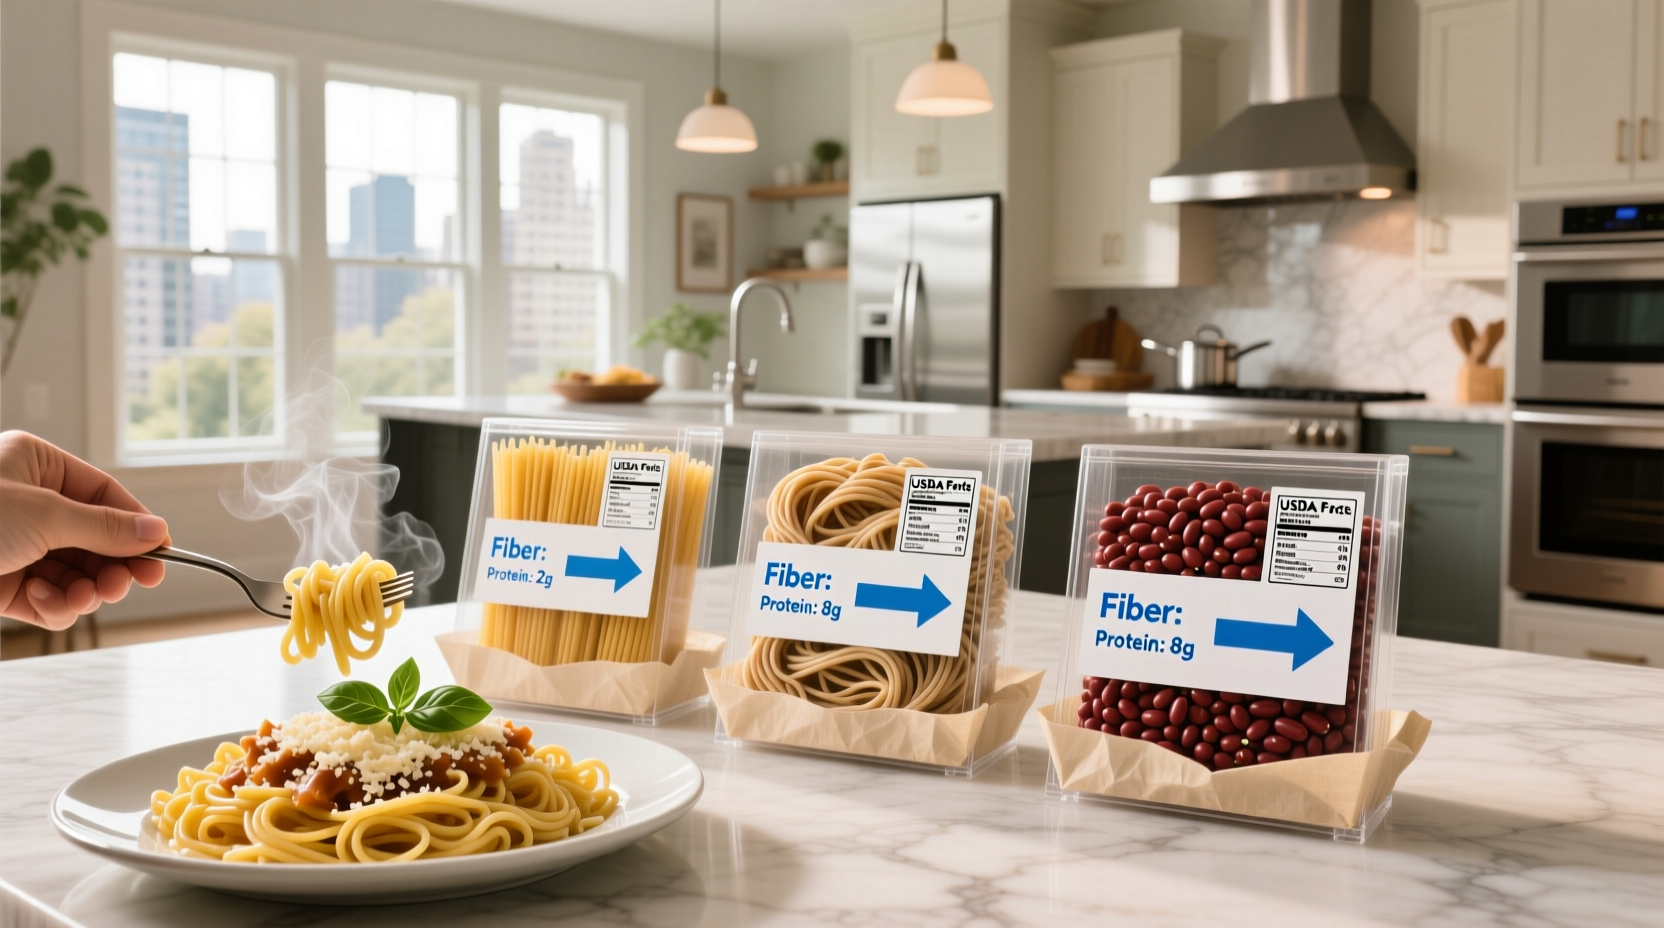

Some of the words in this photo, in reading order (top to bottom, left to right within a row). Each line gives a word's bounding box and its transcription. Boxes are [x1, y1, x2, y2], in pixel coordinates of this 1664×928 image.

[911, 478, 944, 490] USDA
[1280, 498, 1317, 513] USDA
[491, 536, 547, 561] Fiber:
[487, 566, 533, 583] Protein:
[536, 569, 553, 589] 2g
[764, 562, 832, 591] Fiber:
[760, 595, 818, 615] Protein:
[821, 600, 842, 621] 8g
[1100, 592, 1183, 625] Fiber:
[1095, 629, 1165, 653] Protein:
[1170, 636, 1195, 661] 8g
